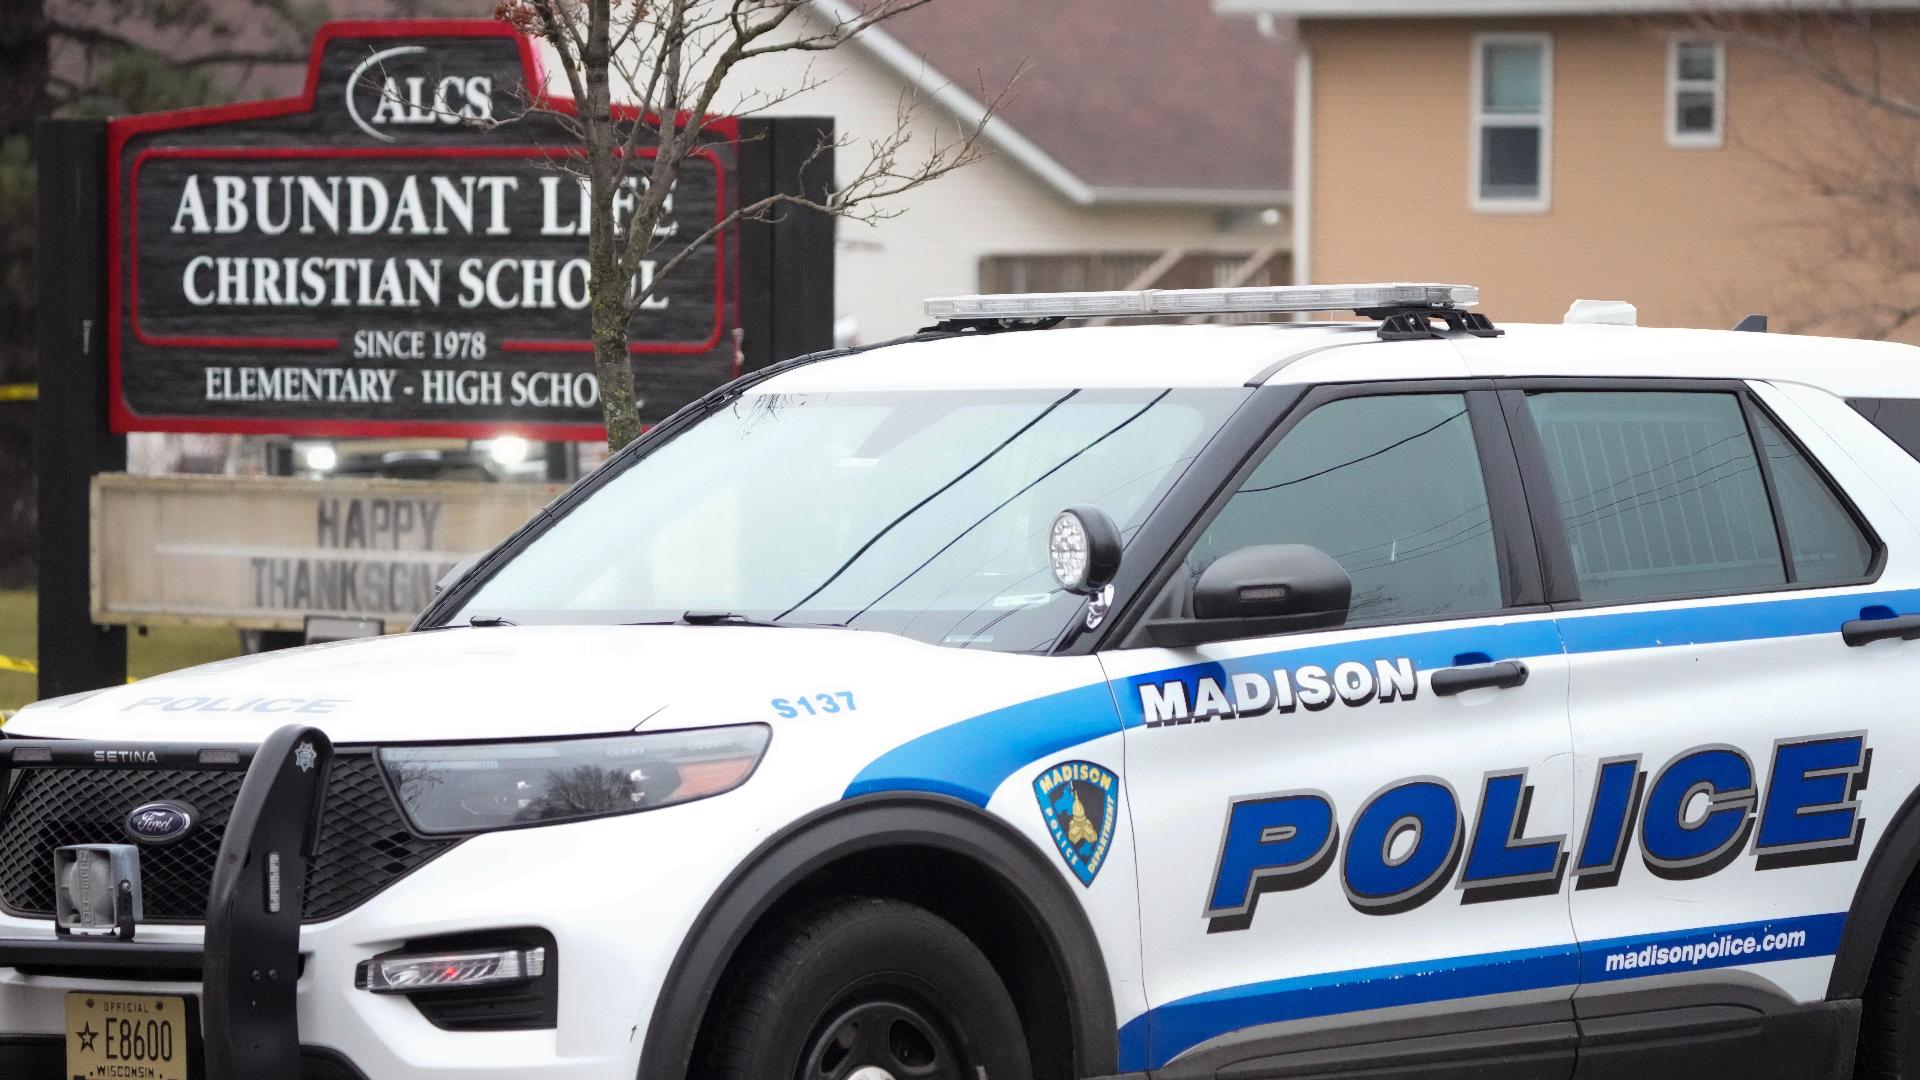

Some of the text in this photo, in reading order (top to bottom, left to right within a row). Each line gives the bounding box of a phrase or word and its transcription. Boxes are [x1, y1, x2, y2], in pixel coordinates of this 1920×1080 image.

[371, 75, 494, 126] ALCS
[171, 174, 519, 235] ABUNDANT
[183, 255, 670, 310] CHRISTIAN SCHOL
[354, 330, 487, 359] SINCE 1978
[205, 367, 396, 402] ELEMENTARY
[421, 370, 503, 405] HIGH
[510, 371, 645, 409] SCHO
[316, 499, 441, 551] HAPPY
[251, 556, 456, 613] THANKSGIV
[120, 696, 350, 715] POLICE
[770, 690, 856, 719] S137
[1139, 656, 1418, 728] MADISON
[93, 749, 158, 764] SETINA
[1040, 764, 1112, 794] MADISON
[136, 811, 173, 833] Ford
[1045, 806, 1078, 866] POLICE
[1203, 729, 1873, 933] POLICE
[1605, 929, 1807, 972] madisonpolice.com
[103, 1001, 149, 1013] OFFICIAL
[105, 1017, 173, 1062] E8600
[96, 1064, 155, 1079] WISCONSIN
